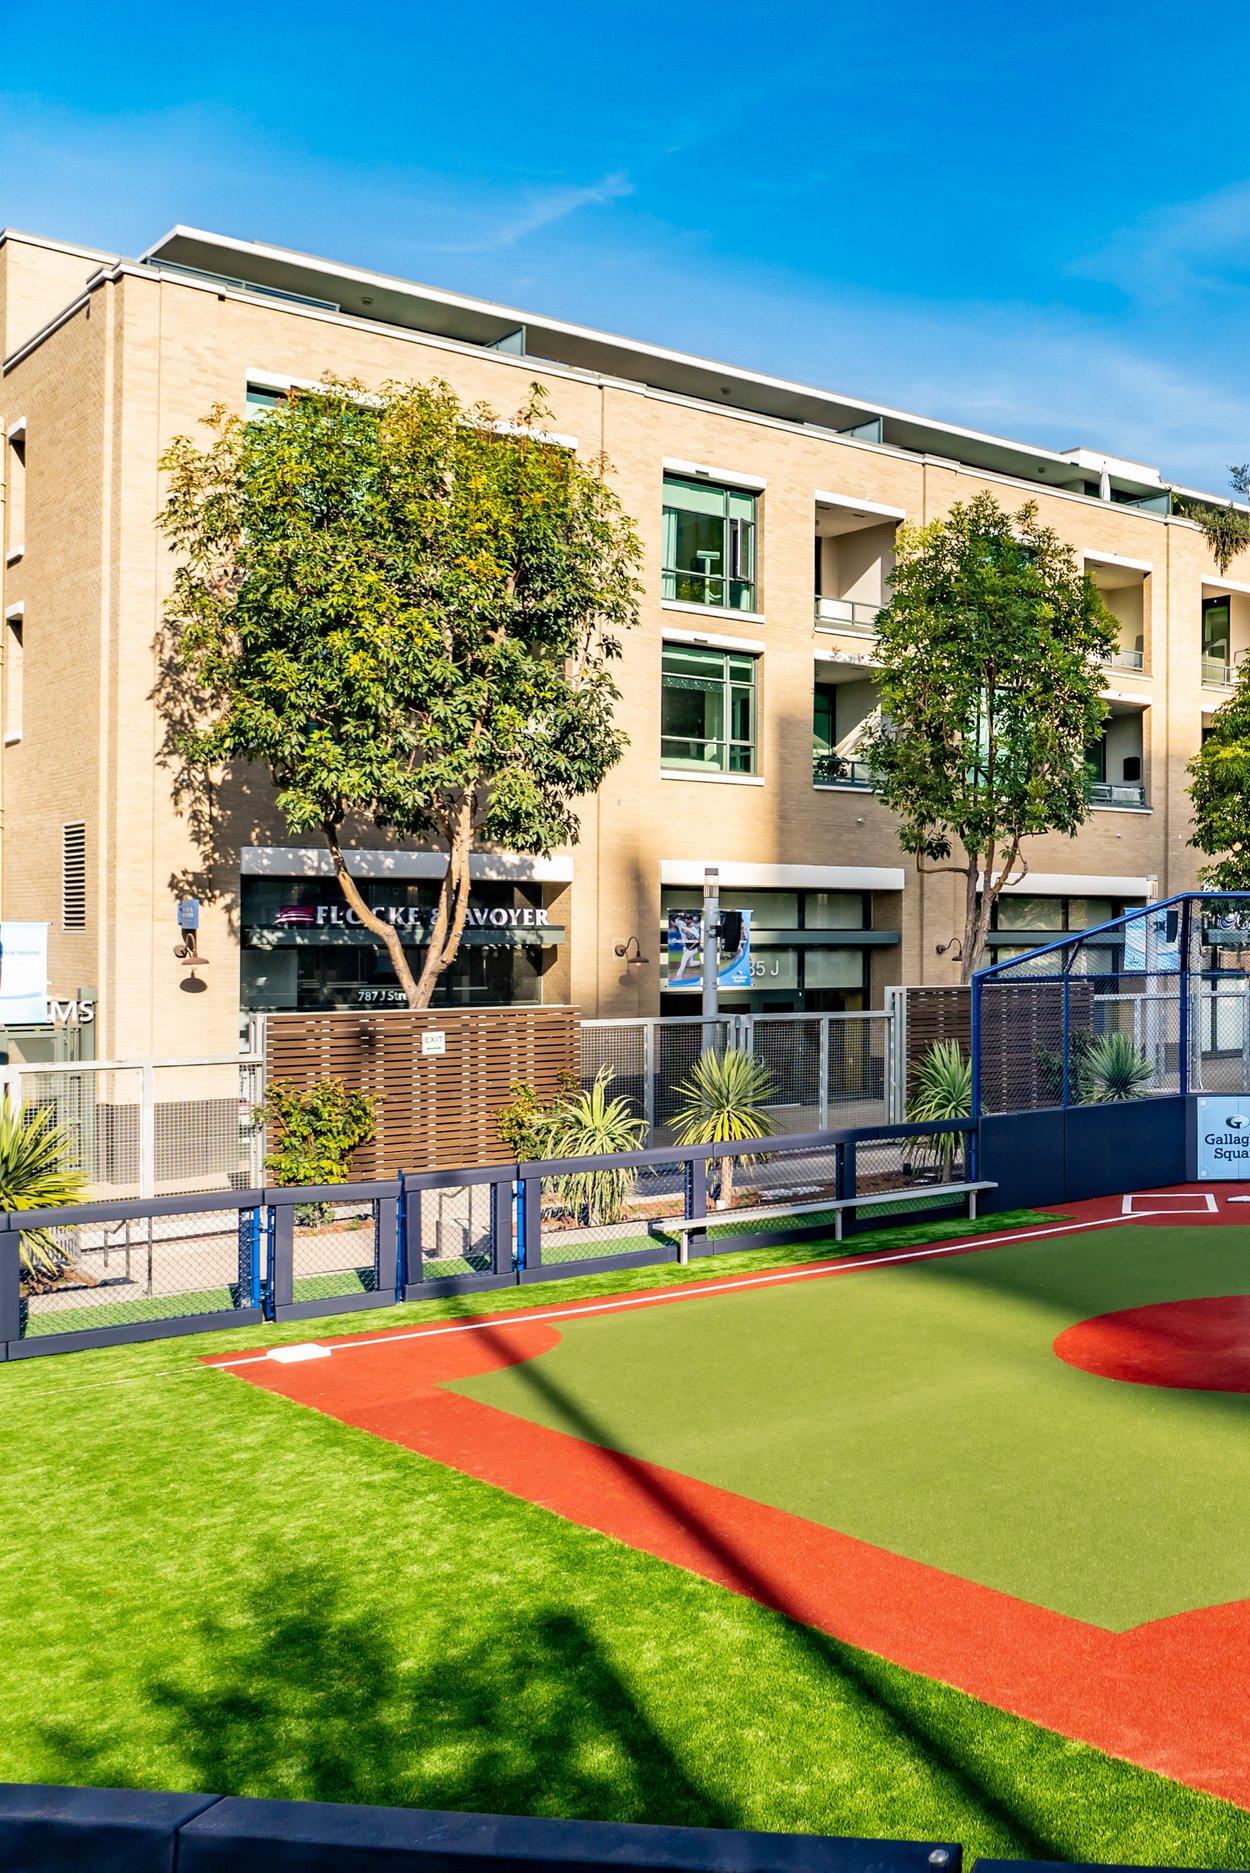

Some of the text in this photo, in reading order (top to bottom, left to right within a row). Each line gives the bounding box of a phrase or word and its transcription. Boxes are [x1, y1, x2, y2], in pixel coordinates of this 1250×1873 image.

[770, 959, 780, 976] J
[358, 991, 408, 1001] 787 J Stre
[47, 1000, 96, 1022] MS
